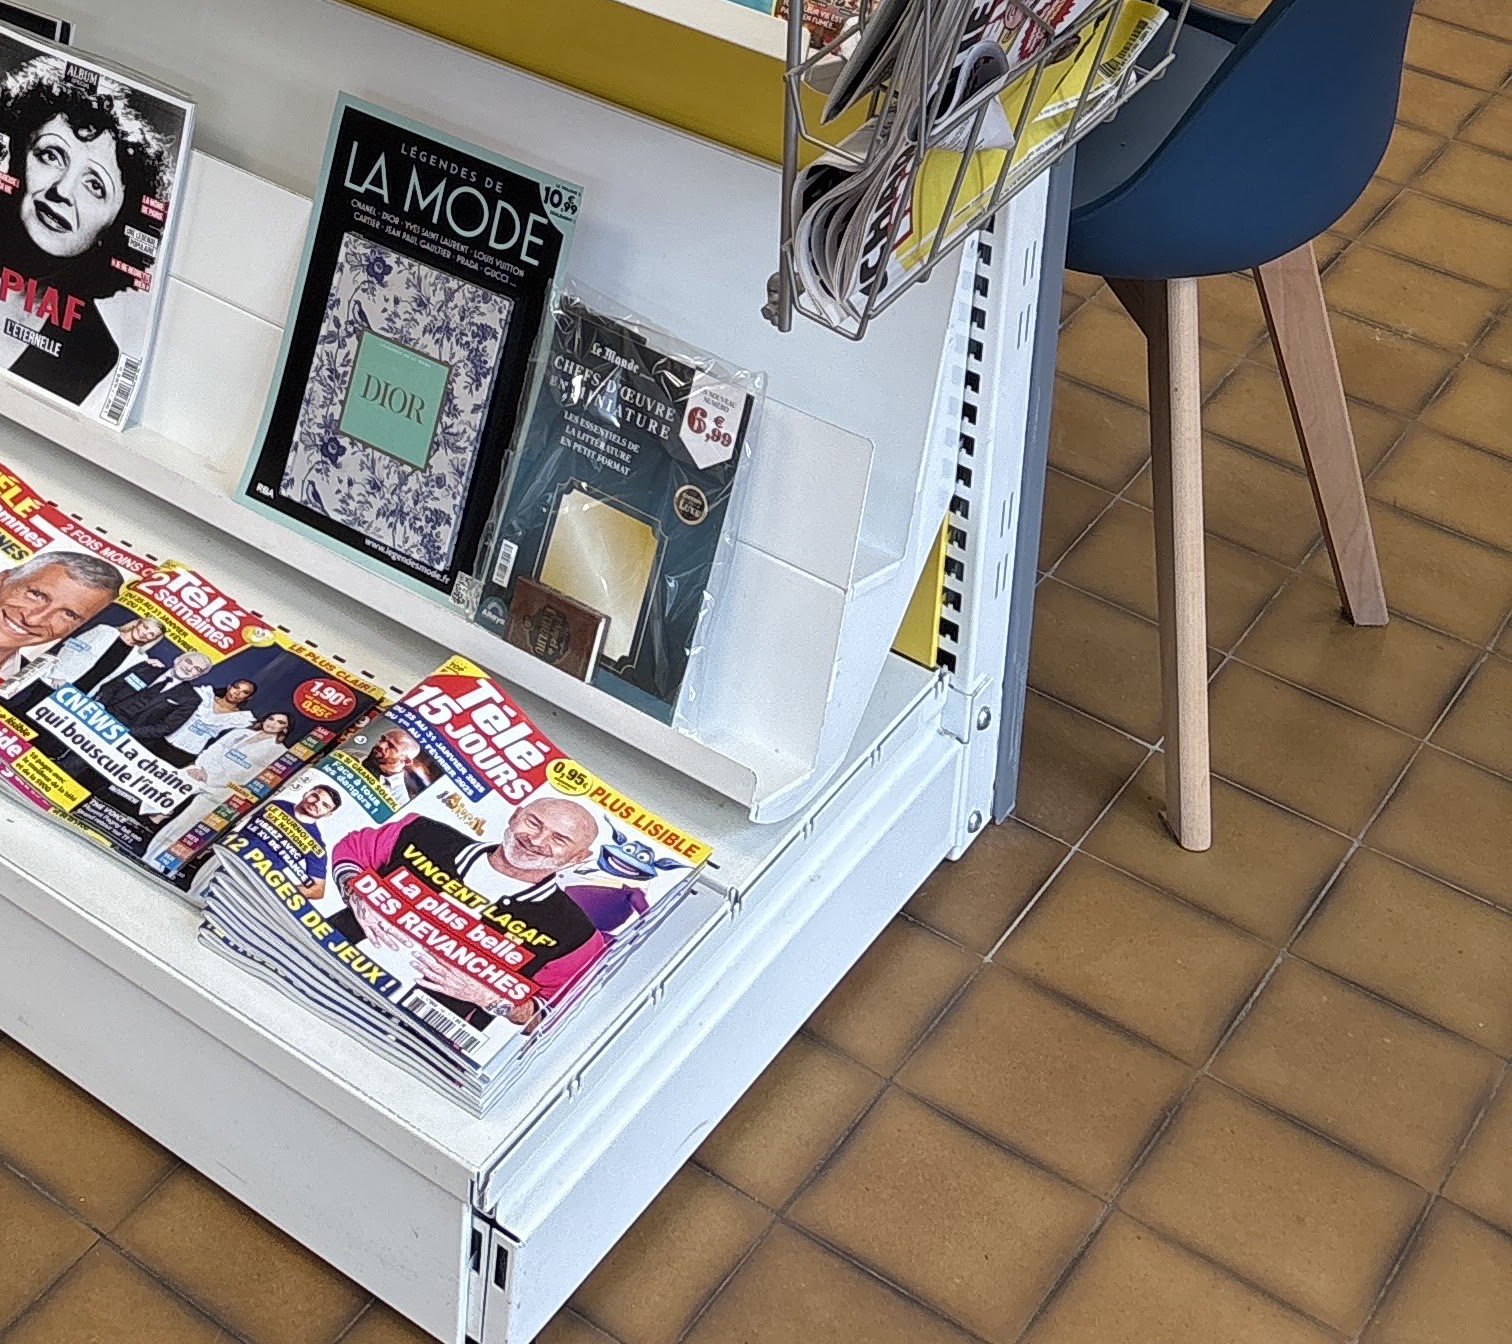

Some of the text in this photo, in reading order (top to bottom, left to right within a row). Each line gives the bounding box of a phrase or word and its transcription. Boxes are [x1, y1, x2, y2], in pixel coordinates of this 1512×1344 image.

[400, 144, 478, 183] LÉGENDES
[342, 141, 548, 266] LA MODE
[590, 343, 640, 373] Le Monde
[360, 373, 427, 426] DIOR
[54, 687, 125, 745] CNEWS
[458, 680, 547, 772] Télé
[439, 720, 532, 801] JOURS
[590, 785, 701, 860] PLUS LISIBLE
[402, 844, 483, 914] VINCENT
[238, 849, 386, 990] PAGES JEUX
[400, 911, 532, 1001] REVANCHES
